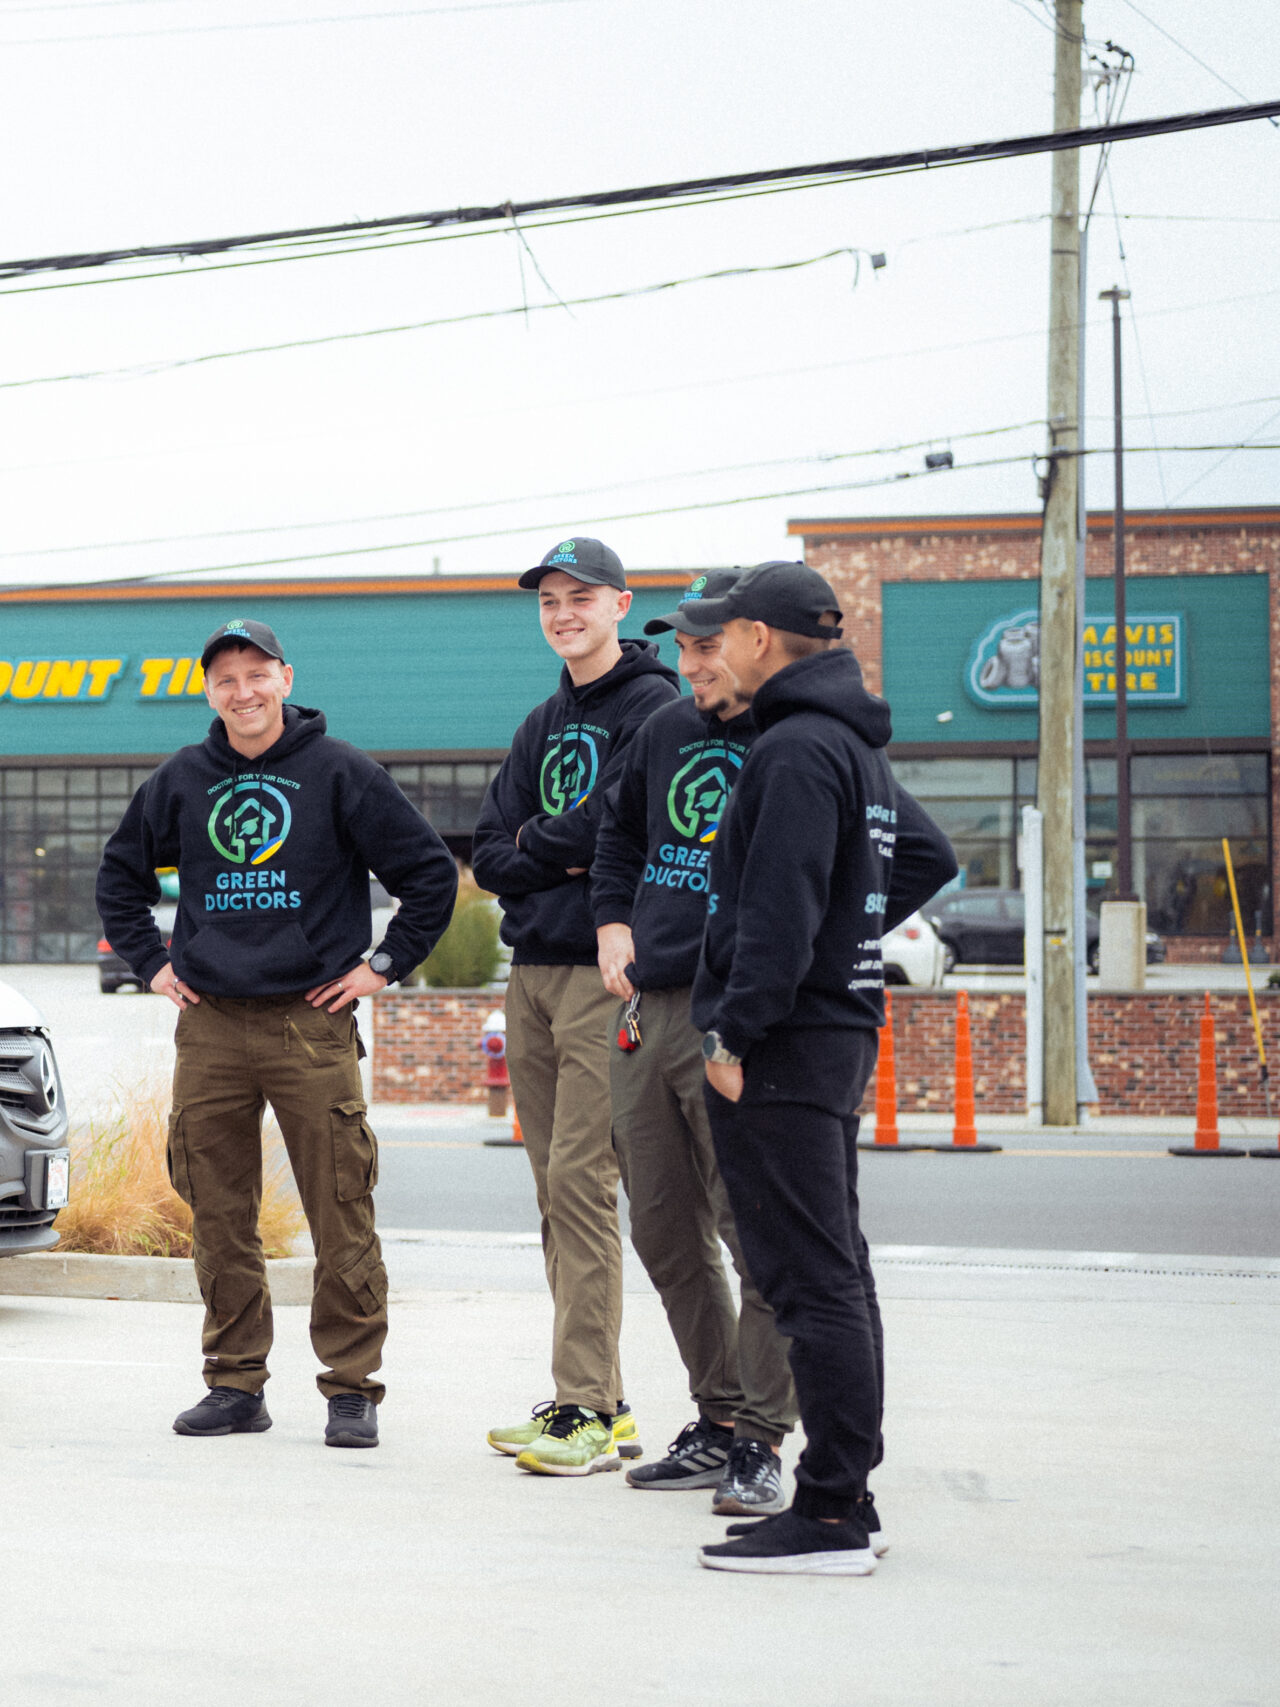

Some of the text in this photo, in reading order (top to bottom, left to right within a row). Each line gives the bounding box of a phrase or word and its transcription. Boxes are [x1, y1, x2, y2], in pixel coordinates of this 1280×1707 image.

[1084, 649, 1174, 668] ISCUNT
[140, 658, 204, 696] TI
[1087, 672, 1157, 691] TIRE
[238, 774, 254, 782] FOR
[276, 776, 300, 789] DUCTS
[659, 844, 711, 868] GREE
[216, 870, 286, 890] GREEN
[205, 891, 302, 912] DUCTORS
